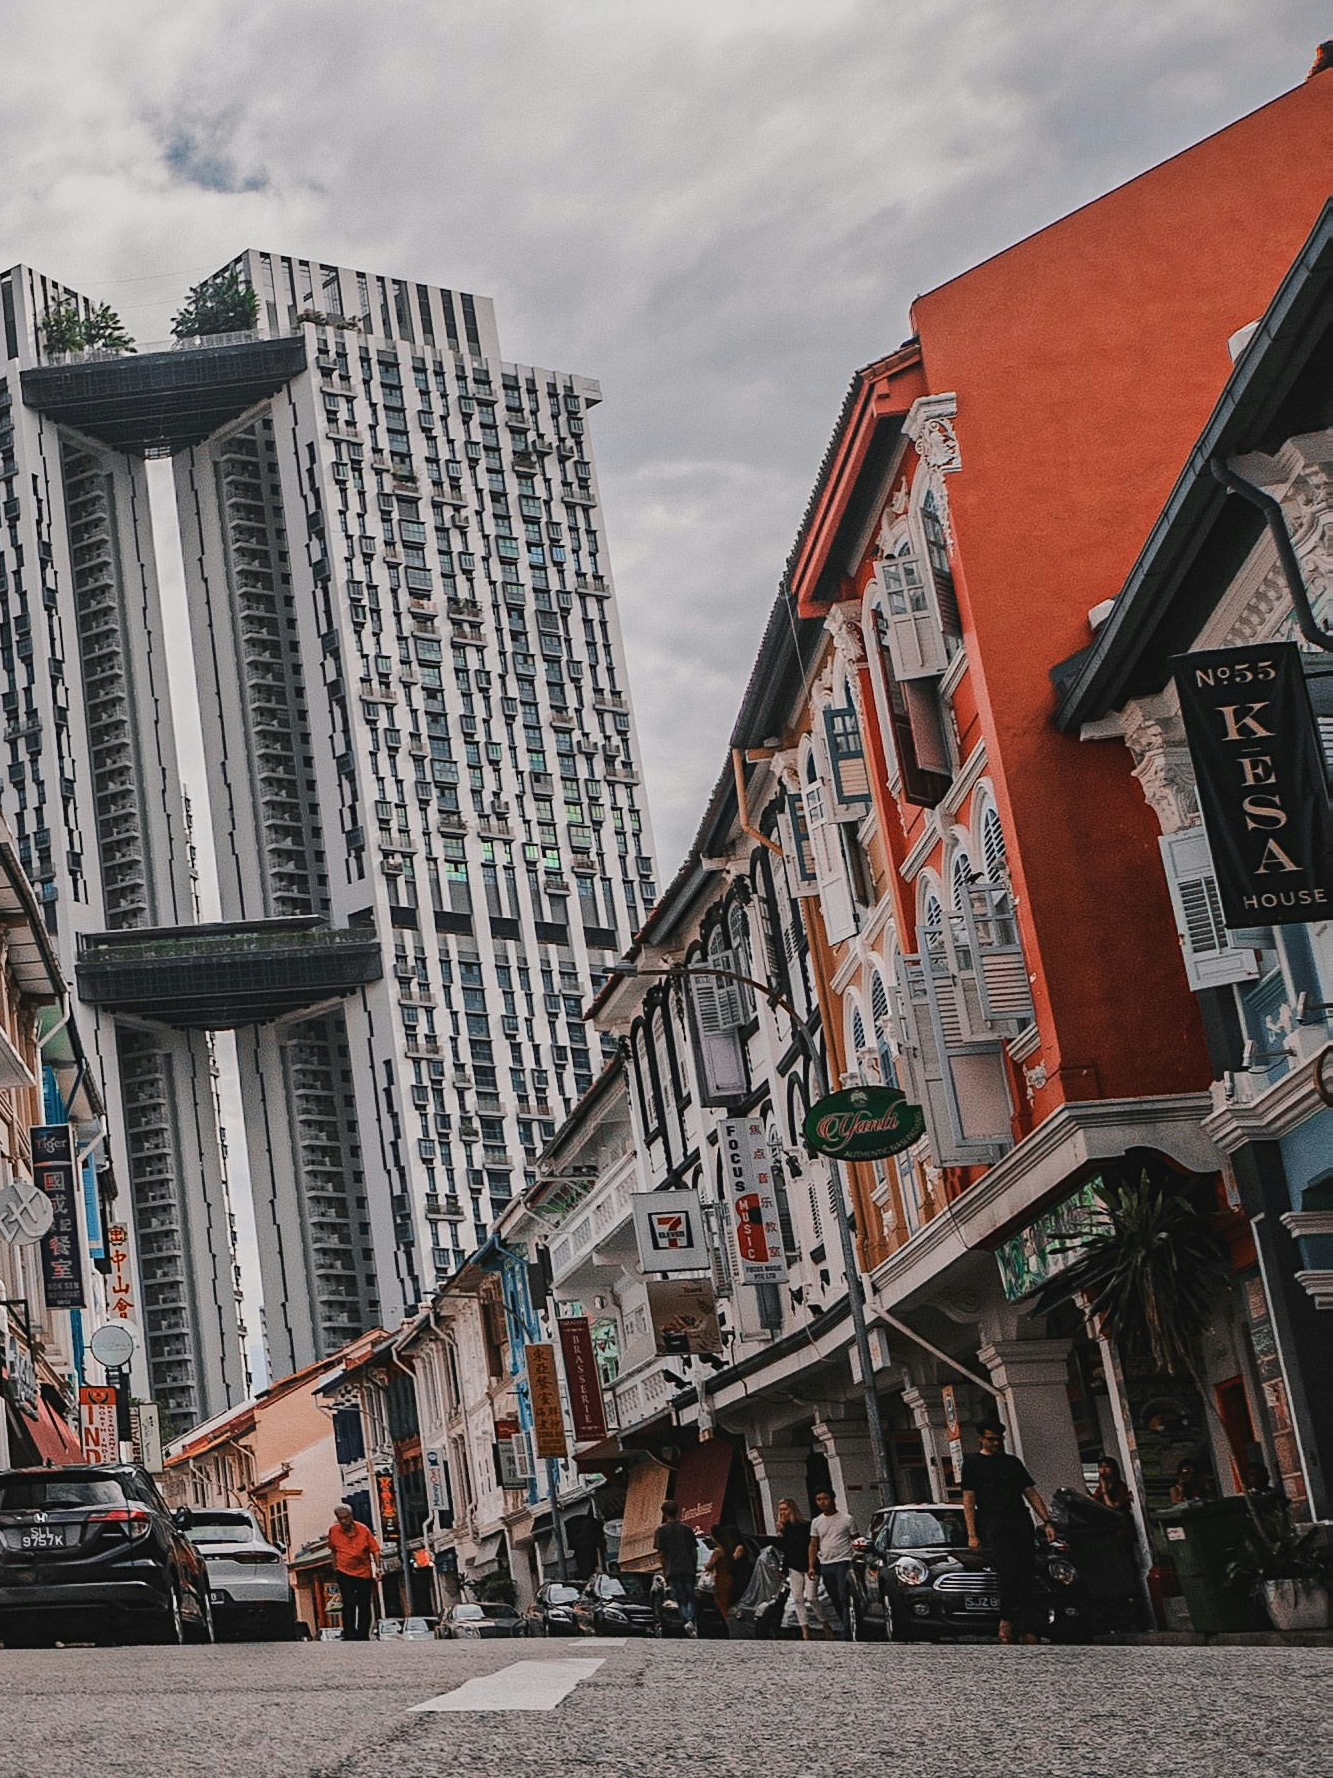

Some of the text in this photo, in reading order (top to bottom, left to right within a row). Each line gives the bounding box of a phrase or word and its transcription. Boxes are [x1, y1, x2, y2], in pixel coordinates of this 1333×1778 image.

[1243, 889, 1328, 910] HOUSE
[36, 1136, 67, 1153] Tiger
[844, 1147, 889, 1158] AUTHENTIC
[726, 1125, 745, 1192] FOCUS
[738, 1199, 756, 1259] MUSIC
[572, 1335, 592, 1423] BRASSERIE
[22, 1535, 63, 1547] 9757K
